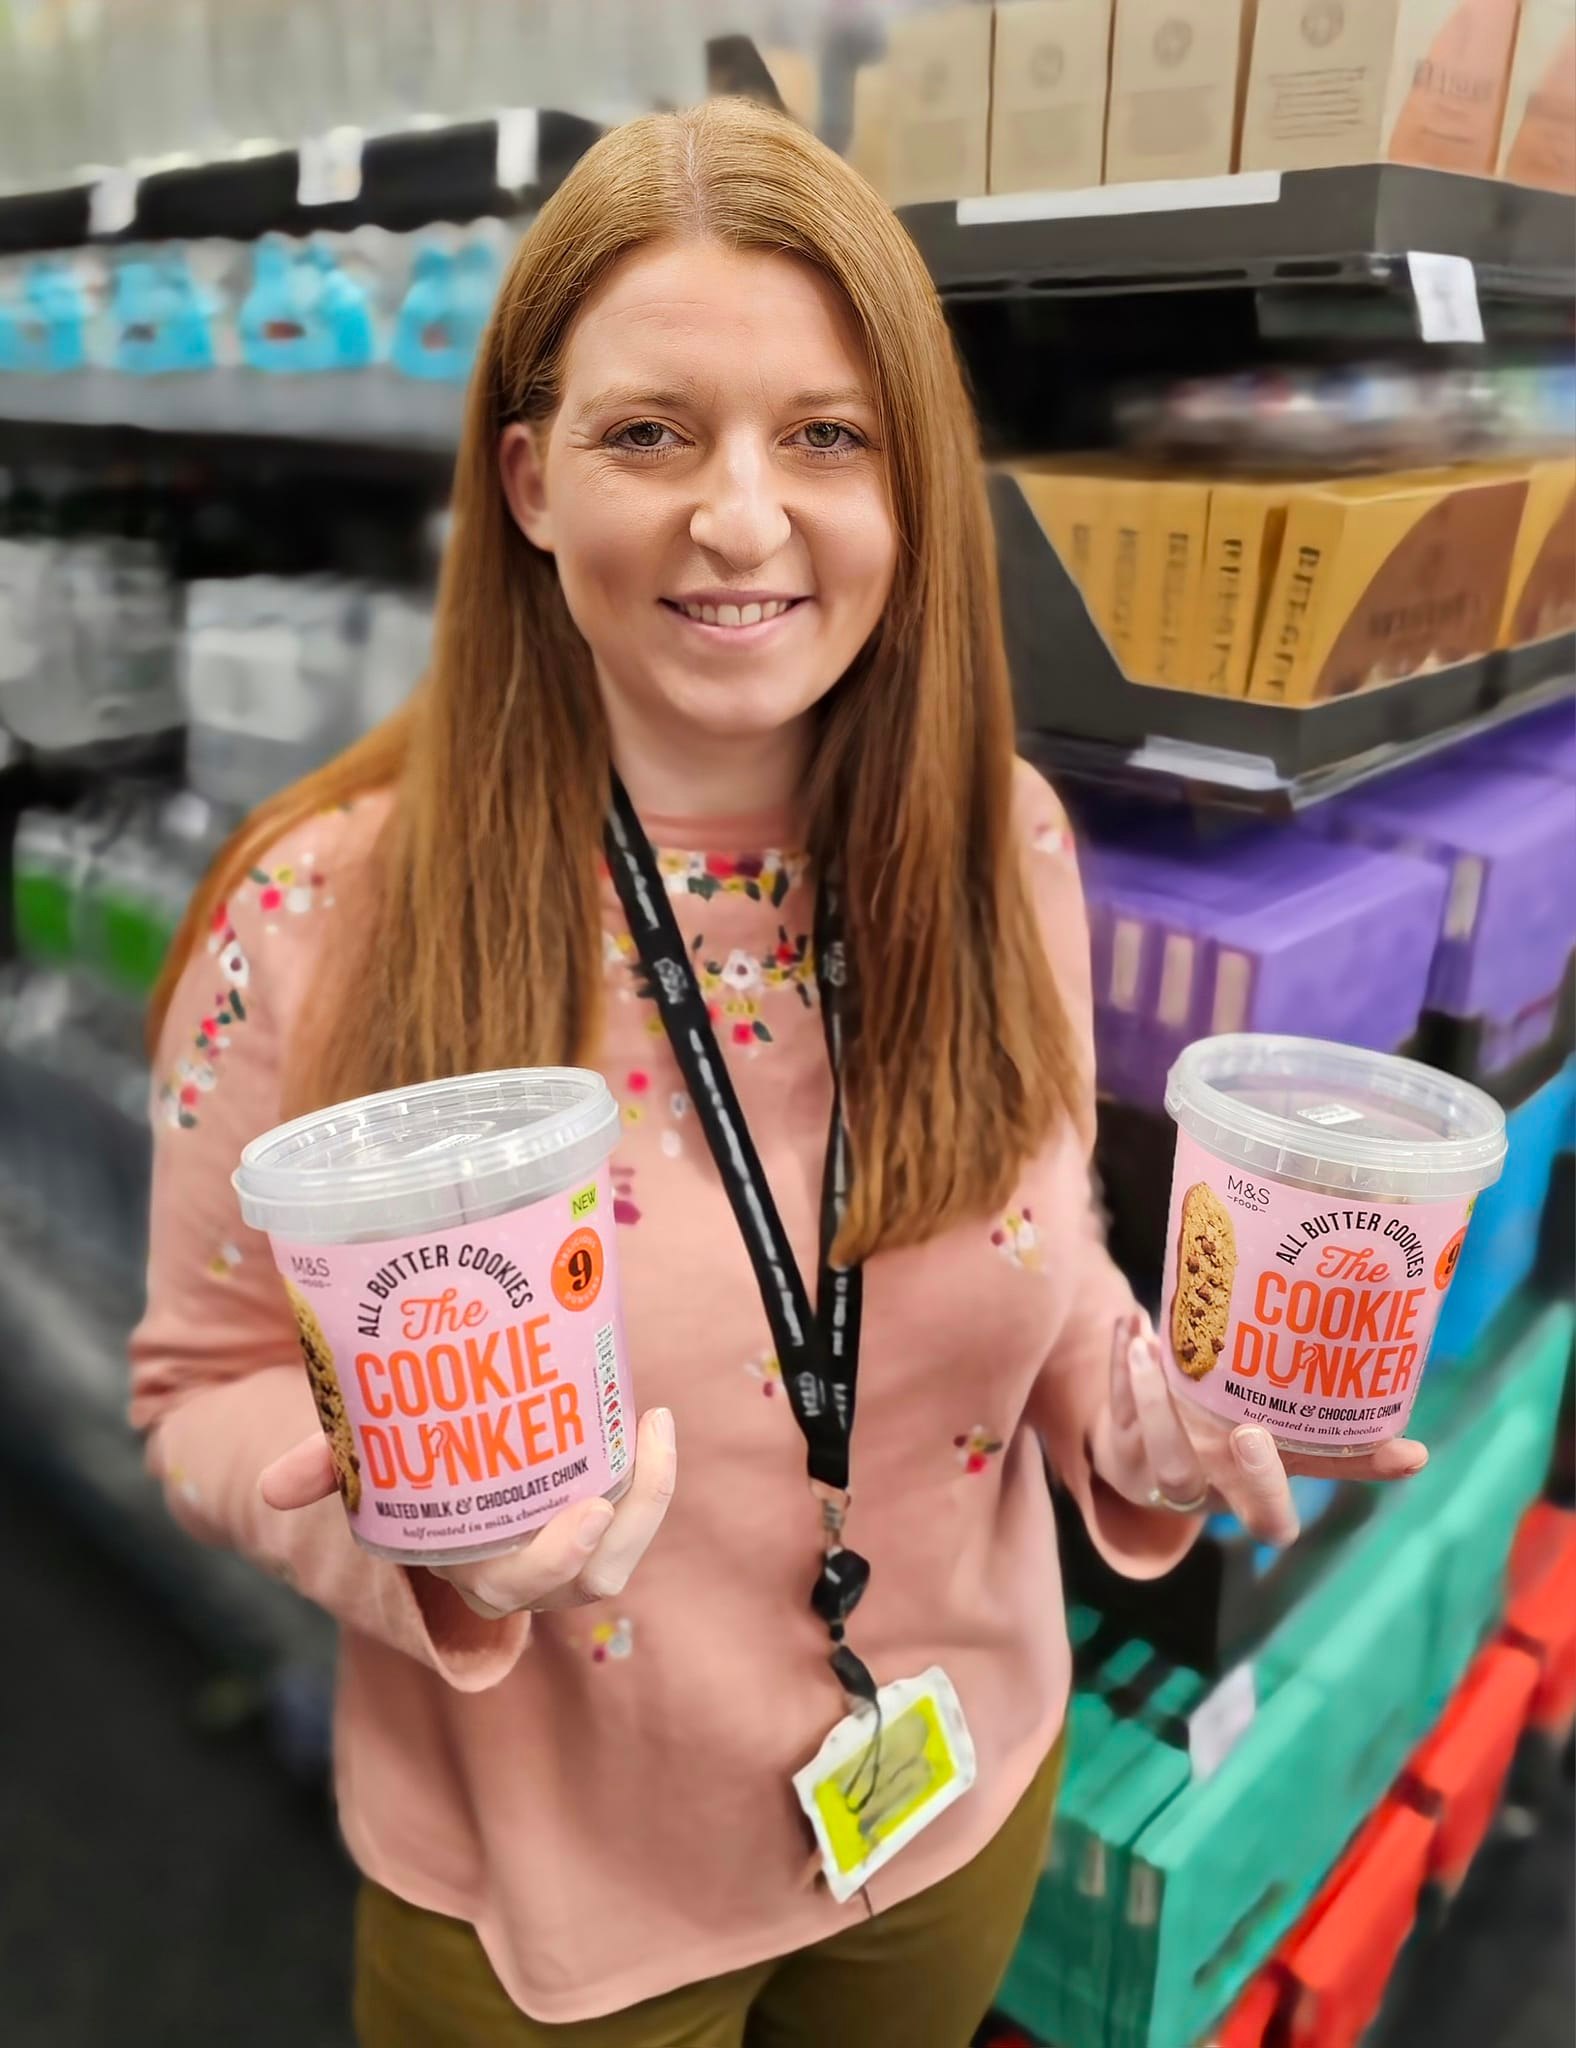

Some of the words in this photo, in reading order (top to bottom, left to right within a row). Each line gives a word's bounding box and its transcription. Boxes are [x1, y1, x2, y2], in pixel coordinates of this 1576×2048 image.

[572, 1187, 597, 1215] NEW
[1227, 1174, 1271, 1206] M&S
[1233, 1196, 1258, 1212] FOOD
[568, 1249, 592, 1291] 9
[1275, 1233, 1308, 1266] ALL
[1300, 1211, 1382, 1240] BUTTER
[1383, 1218, 1425, 1279] COOKIES
[1315, 1245, 1391, 1283] The
[366, 1244, 450, 1300] BUTTER
[457, 1243, 535, 1310] COOKIES
[357, 1302, 383, 1339] ALL
[400, 1287, 489, 1341] The
[1254, 1270, 1427, 1343] COOKIE
[354, 1313, 559, 1420] COOKIE
[1231, 1320, 1419, 1399] DUNKER
[1224, 1380, 1267, 1407] MALTED
[1268, 1396, 1298, 1415] MILK
[1318, 1406, 1375, 1421] CHOCOLATE
[1243, 1408, 1267, 1423] half
[1266, 1416, 1302, 1432] coated
[1304, 1424, 1315, 1433] in
[1318, 1425, 1341, 1436] milk
[1343, 1425, 1384, 1437] chocolate
[358, 1382, 585, 1490] DUNKER
[375, 1500, 419, 1520] MALTED
[421, 1501, 453, 1519] MILK
[476, 1475, 551, 1512] CHOCOLATE
[553, 1456, 590, 1488] CHUNK
[402, 1525, 427, 1541] half
[426, 1524, 466, 1538] coated
[469, 1522, 482, 1533] in
[485, 1513, 515, 1531] milk
[516, 1494, 571, 1523] chocolate
